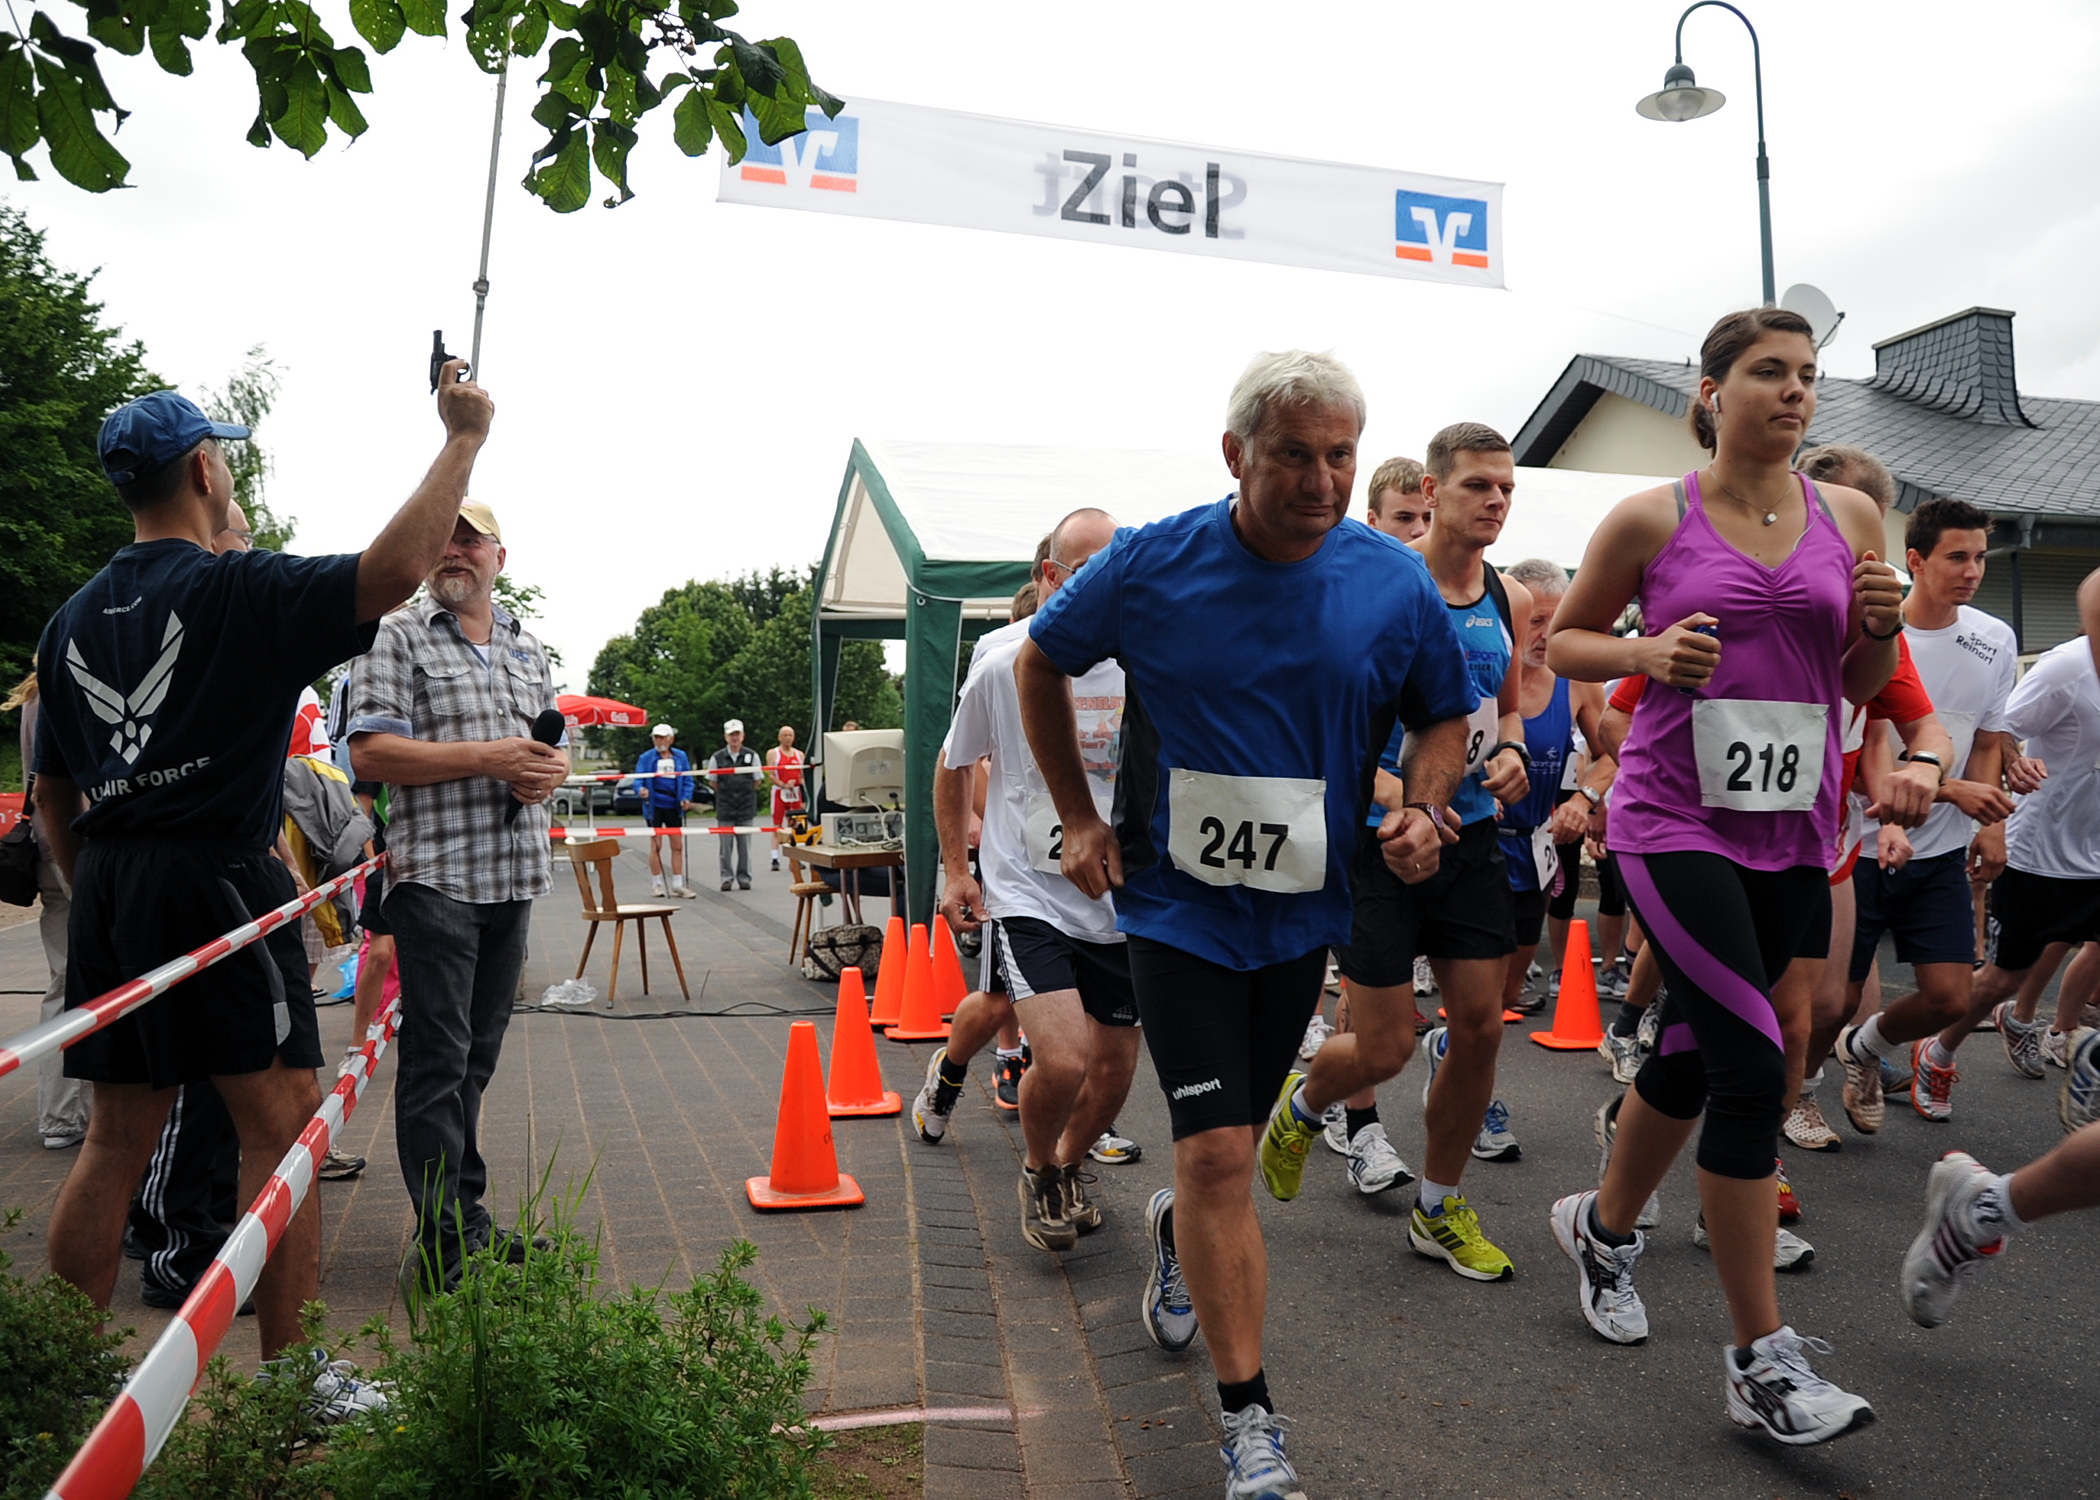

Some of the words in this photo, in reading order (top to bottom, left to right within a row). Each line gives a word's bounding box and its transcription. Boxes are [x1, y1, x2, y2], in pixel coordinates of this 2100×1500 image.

[1061, 149, 1220, 239] Ziel
[1955, 635, 1993, 665] Reinart
[1970, 632, 1997, 656] Sport
[135, 756, 211, 788] FORCE
[1726, 741, 1799, 793] 218
[1199, 816, 1289, 872] 247
[1171, 1077, 1223, 1101] uhlsport
